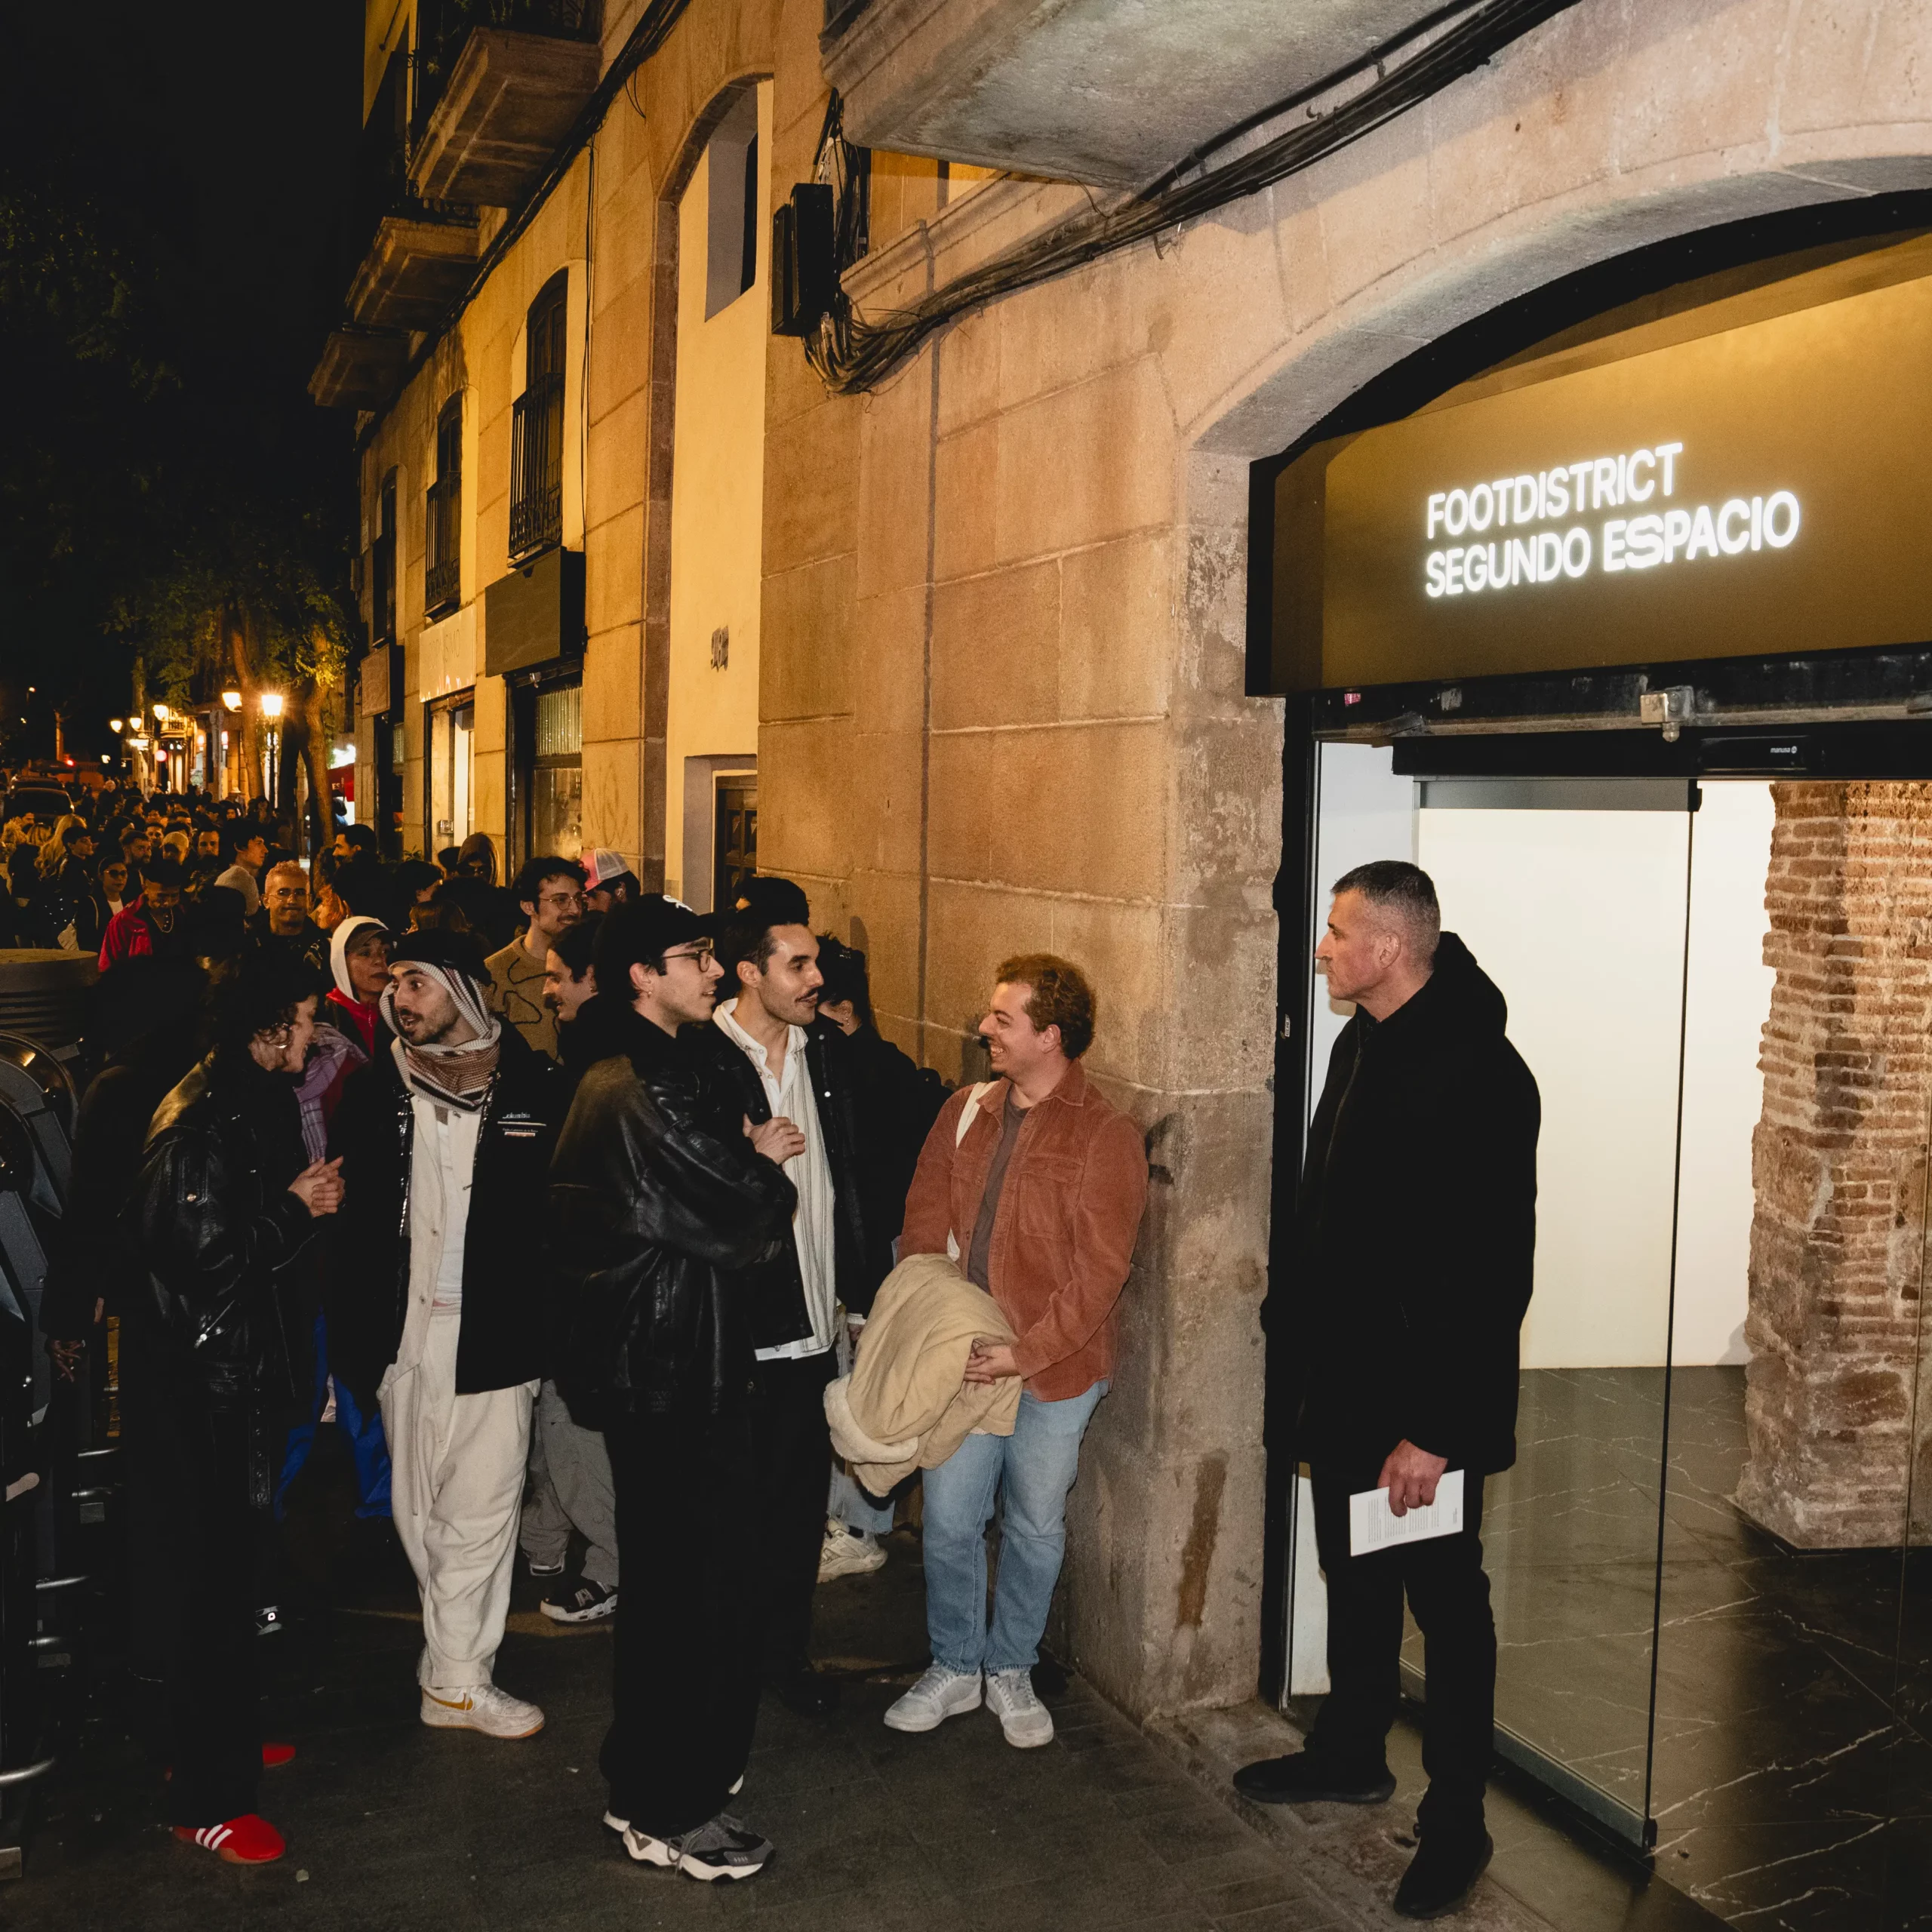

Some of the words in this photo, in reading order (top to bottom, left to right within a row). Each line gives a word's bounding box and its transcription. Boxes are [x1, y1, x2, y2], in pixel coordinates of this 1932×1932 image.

[1428, 442, 1683, 539] FOOTDISTRICT
[1426, 528, 1591, 597] SEGUNDO
[1604, 491, 1799, 571] ESPACIO
